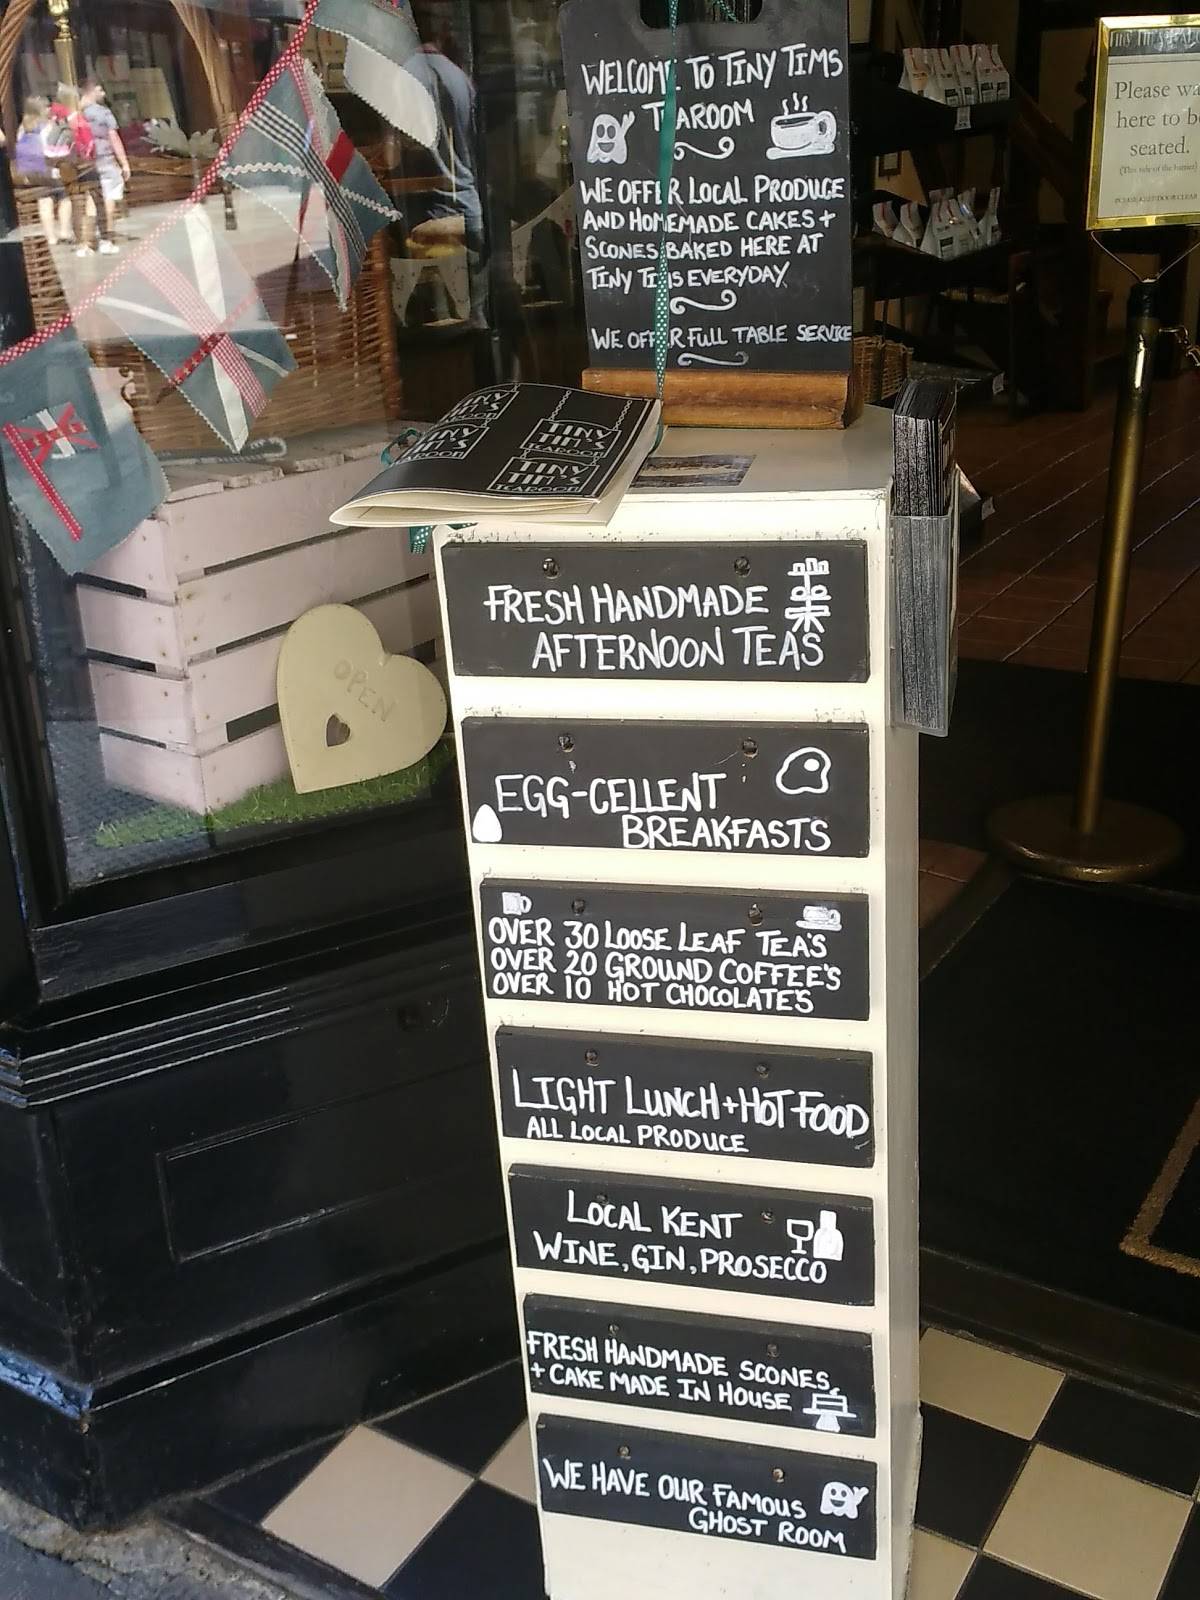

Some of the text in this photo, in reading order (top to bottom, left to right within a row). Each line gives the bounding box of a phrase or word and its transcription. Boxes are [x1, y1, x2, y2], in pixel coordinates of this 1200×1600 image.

[685, 55, 715, 90] TO
[718, 50, 777, 89] TINY
[781, 43, 843, 78] TIMS
[1113, 81, 1170, 100] Please
[641, 98, 755, 131] TAROOM
[1116, 106, 1200, 129] here to b
[1130, 135, 1190, 157] seated.
[580, 177, 614, 204] WE
[689, 176, 748, 205] LOCAL
[755, 175, 845, 200] PRODUCE
[583, 210, 625, 231] AND
[629, 207, 740, 234] HOMEMADE
[746, 209, 815, 231] CAKES
[585, 233, 825, 260] SCONES BAKED HERE AT
[587, 265, 632, 294] TINY
[591, 324, 852, 350] WE OFFR FULL TABLE SERVICE
[539, 433, 605, 450] TIM'S
[549, 422, 612, 439] TINY
[509, 472, 581, 485] TIM'S
[520, 461, 590, 475] TINY
[484, 583, 769, 625] FRESH HANDMADE
[532, 625, 825, 672] AFTERNOON TEAS
[334, 658, 397, 723] OPEN
[495, 772, 726, 819] EGG-CELLENT
[622, 815, 831, 852] BREAKFASTS
[488, 918, 827, 958] OVER 30 LOOSE LEAF TEA'S
[491, 948, 842, 991] OVER 20 GROUND COFFEE'S
[492, 972, 555, 996] OVER
[566, 976, 592, 999] 10
[608, 982, 660, 1003] HOT
[512, 1068, 616, 1116] LIGHT
[789, 1091, 870, 1138] FOOD
[527, 1116, 749, 1153] ALL LOCAL PRODUCE
[567, 1189, 743, 1240] LOCAL KENT
[701, 1250, 827, 1284] PROSECCO
[526, 1330, 831, 1391] FRESH HANDMADE SCONES
[549, 1364, 605, 1391] CAKE
[609, 1370, 671, 1397] MADE
[677, 1378, 713, 1401] IN
[718, 1381, 793, 1412] HOUSE
[543, 1458, 808, 1519] WE HAVE OUR FAMOUS
[688, 1507, 847, 1554] GHOST ROOM
